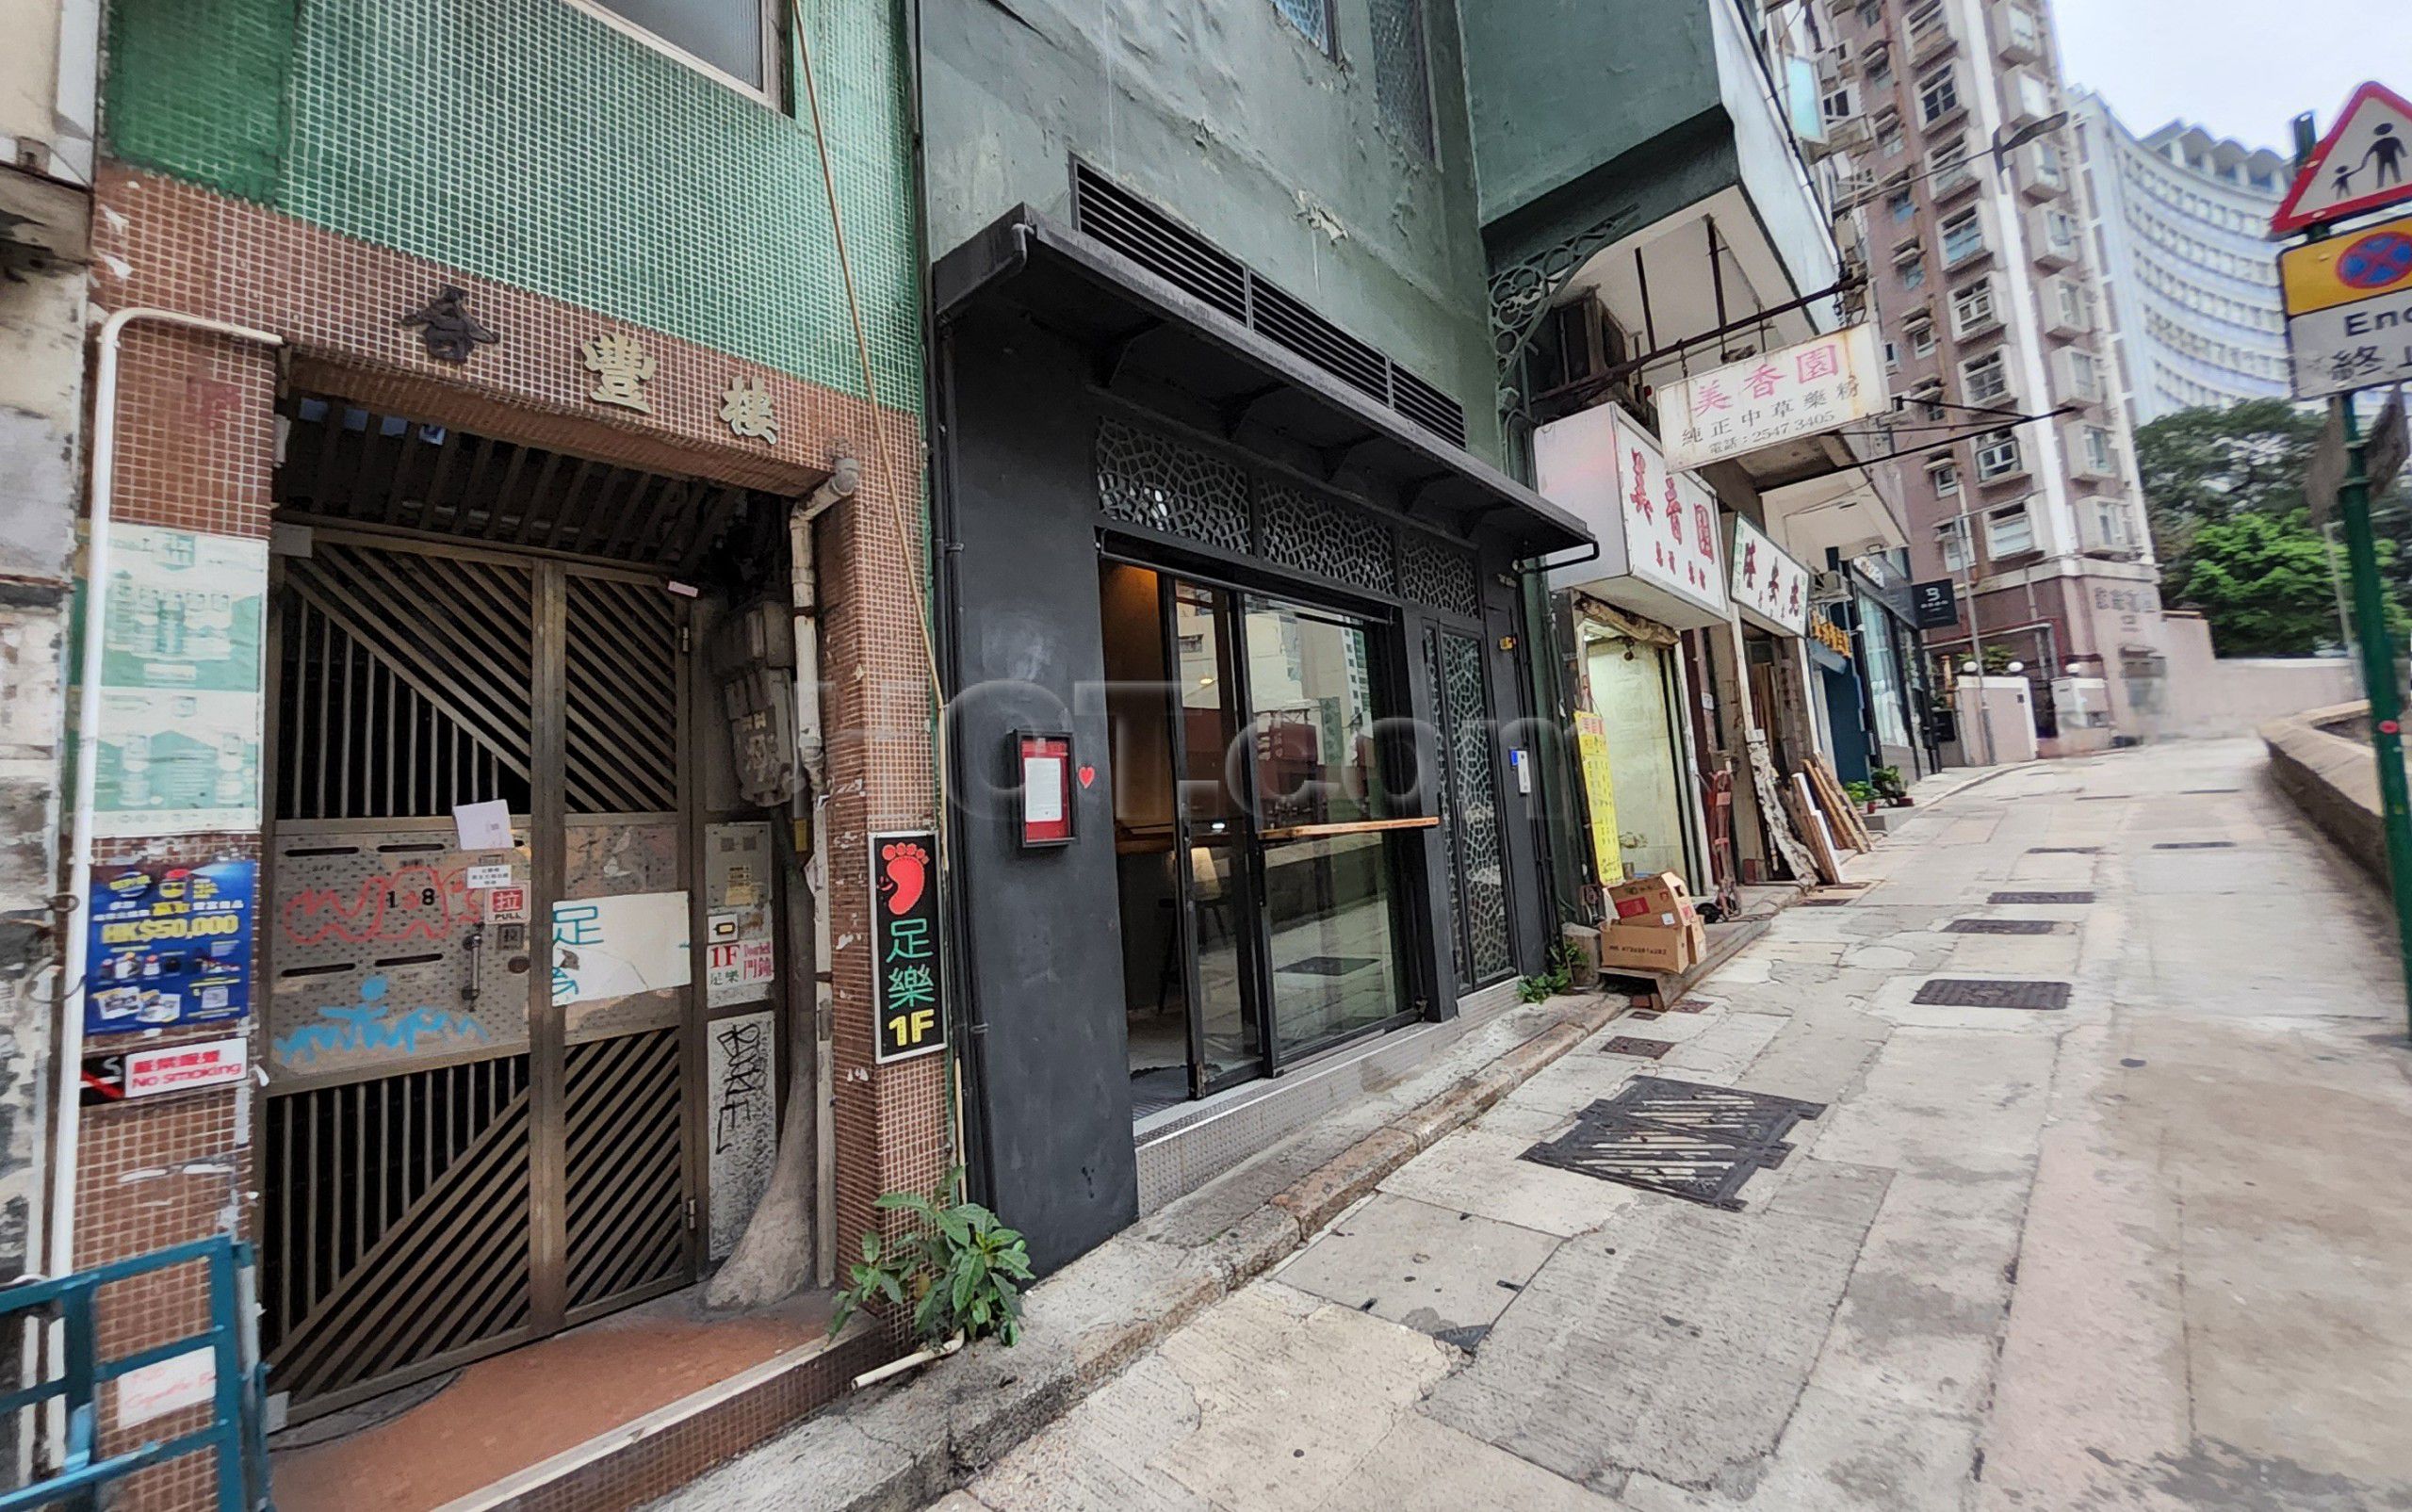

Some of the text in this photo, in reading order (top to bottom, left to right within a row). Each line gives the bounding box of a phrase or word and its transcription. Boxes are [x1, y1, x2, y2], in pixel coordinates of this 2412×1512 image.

[1691, 343, 1839, 417] 美香園
[1752, 421, 1789, 444] 2547
[493, 889, 524, 912] 拉
[553, 905, 604, 946] 足
[710, 944, 741, 969] 1F
[886, 917, 936, 1010] 足樂
[888, 1008, 936, 1047] 1F
